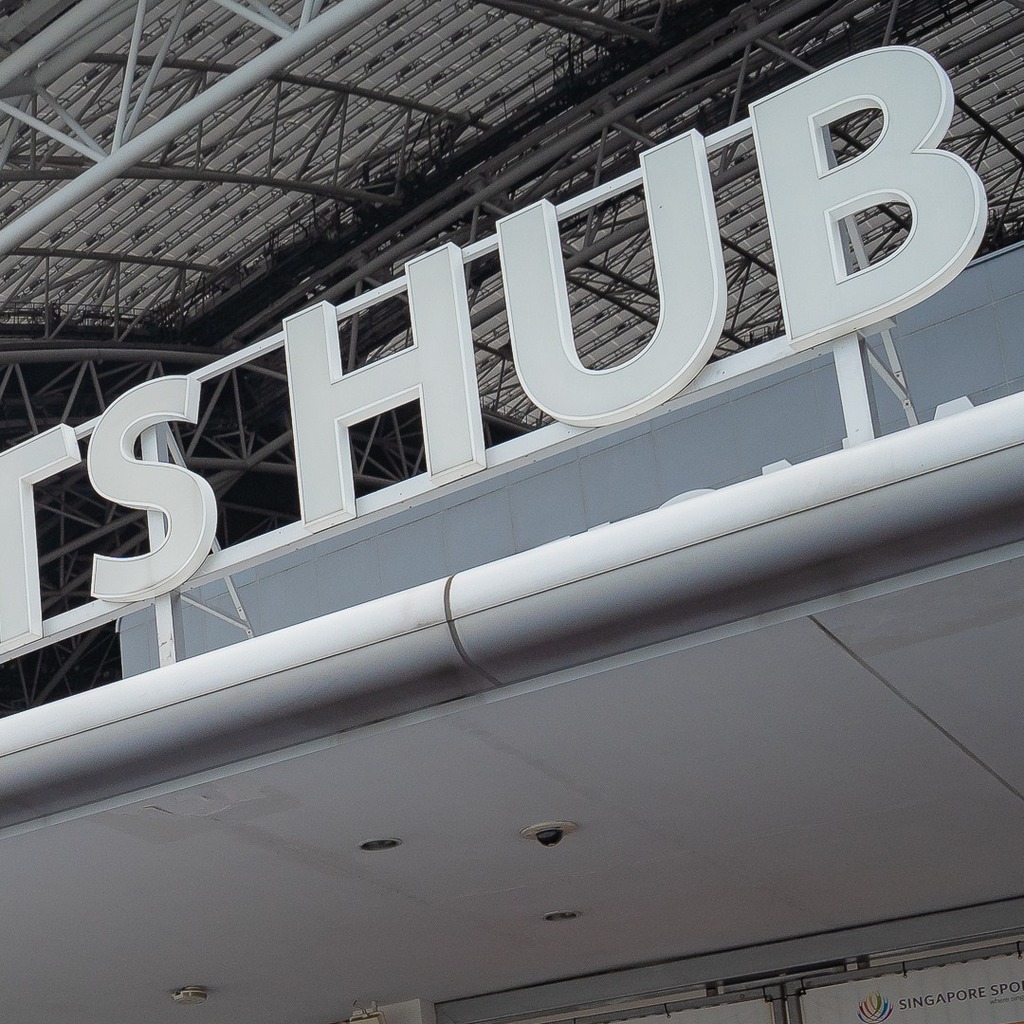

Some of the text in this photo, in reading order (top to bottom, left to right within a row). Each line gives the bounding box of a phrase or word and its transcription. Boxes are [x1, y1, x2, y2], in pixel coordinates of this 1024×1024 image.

[283, 45, 988, 533] HUB
[899, 980, 1024, 1010] SINGAPORE SPO
